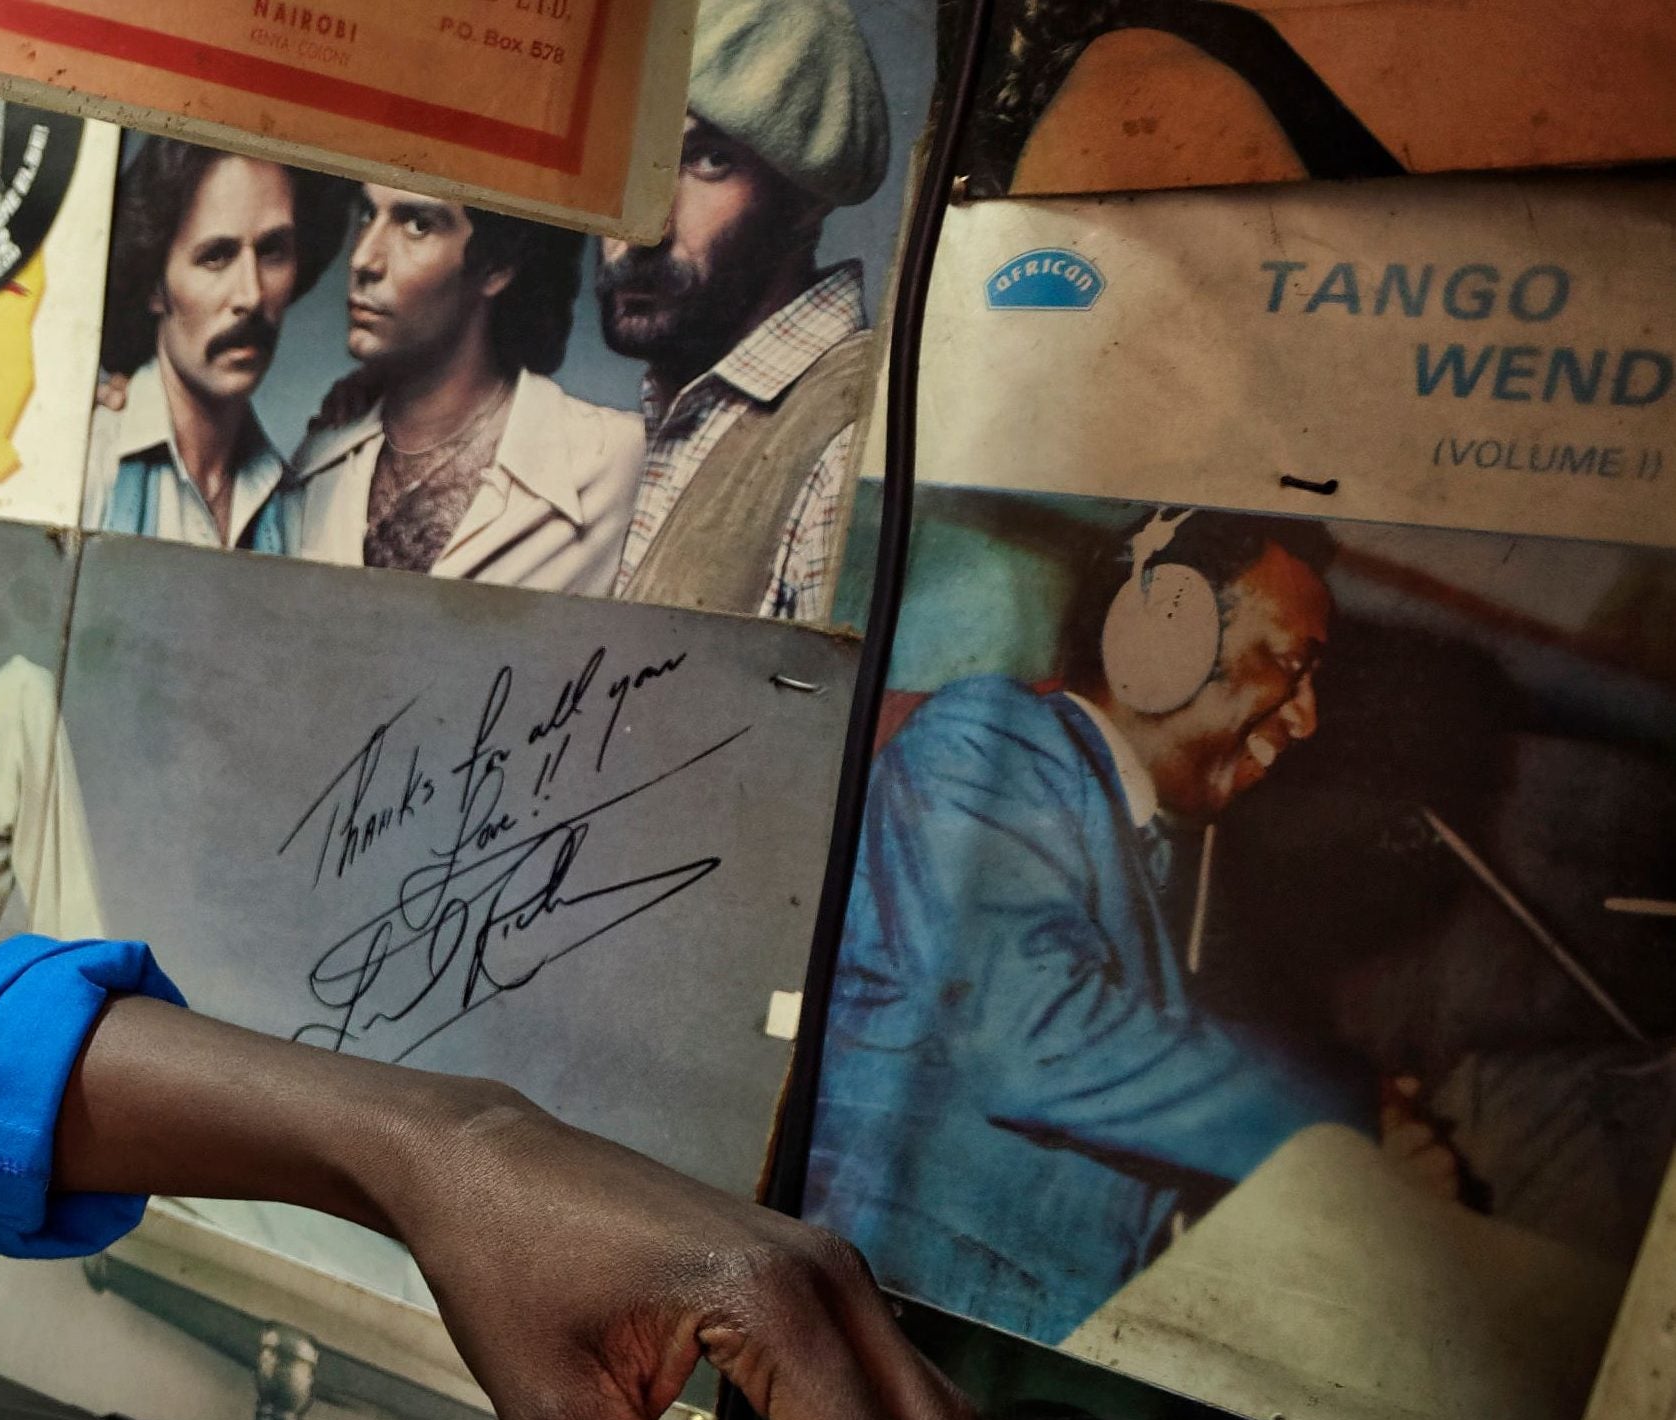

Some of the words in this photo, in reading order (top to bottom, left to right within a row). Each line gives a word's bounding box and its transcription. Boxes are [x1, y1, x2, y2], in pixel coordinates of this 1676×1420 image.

[252, 0, 357, 43] NAIROBI
[484, 28, 523, 53] Box
[1260, 260, 1571, 324] TANGO
[1414, 342, 1675, 408] WEND
